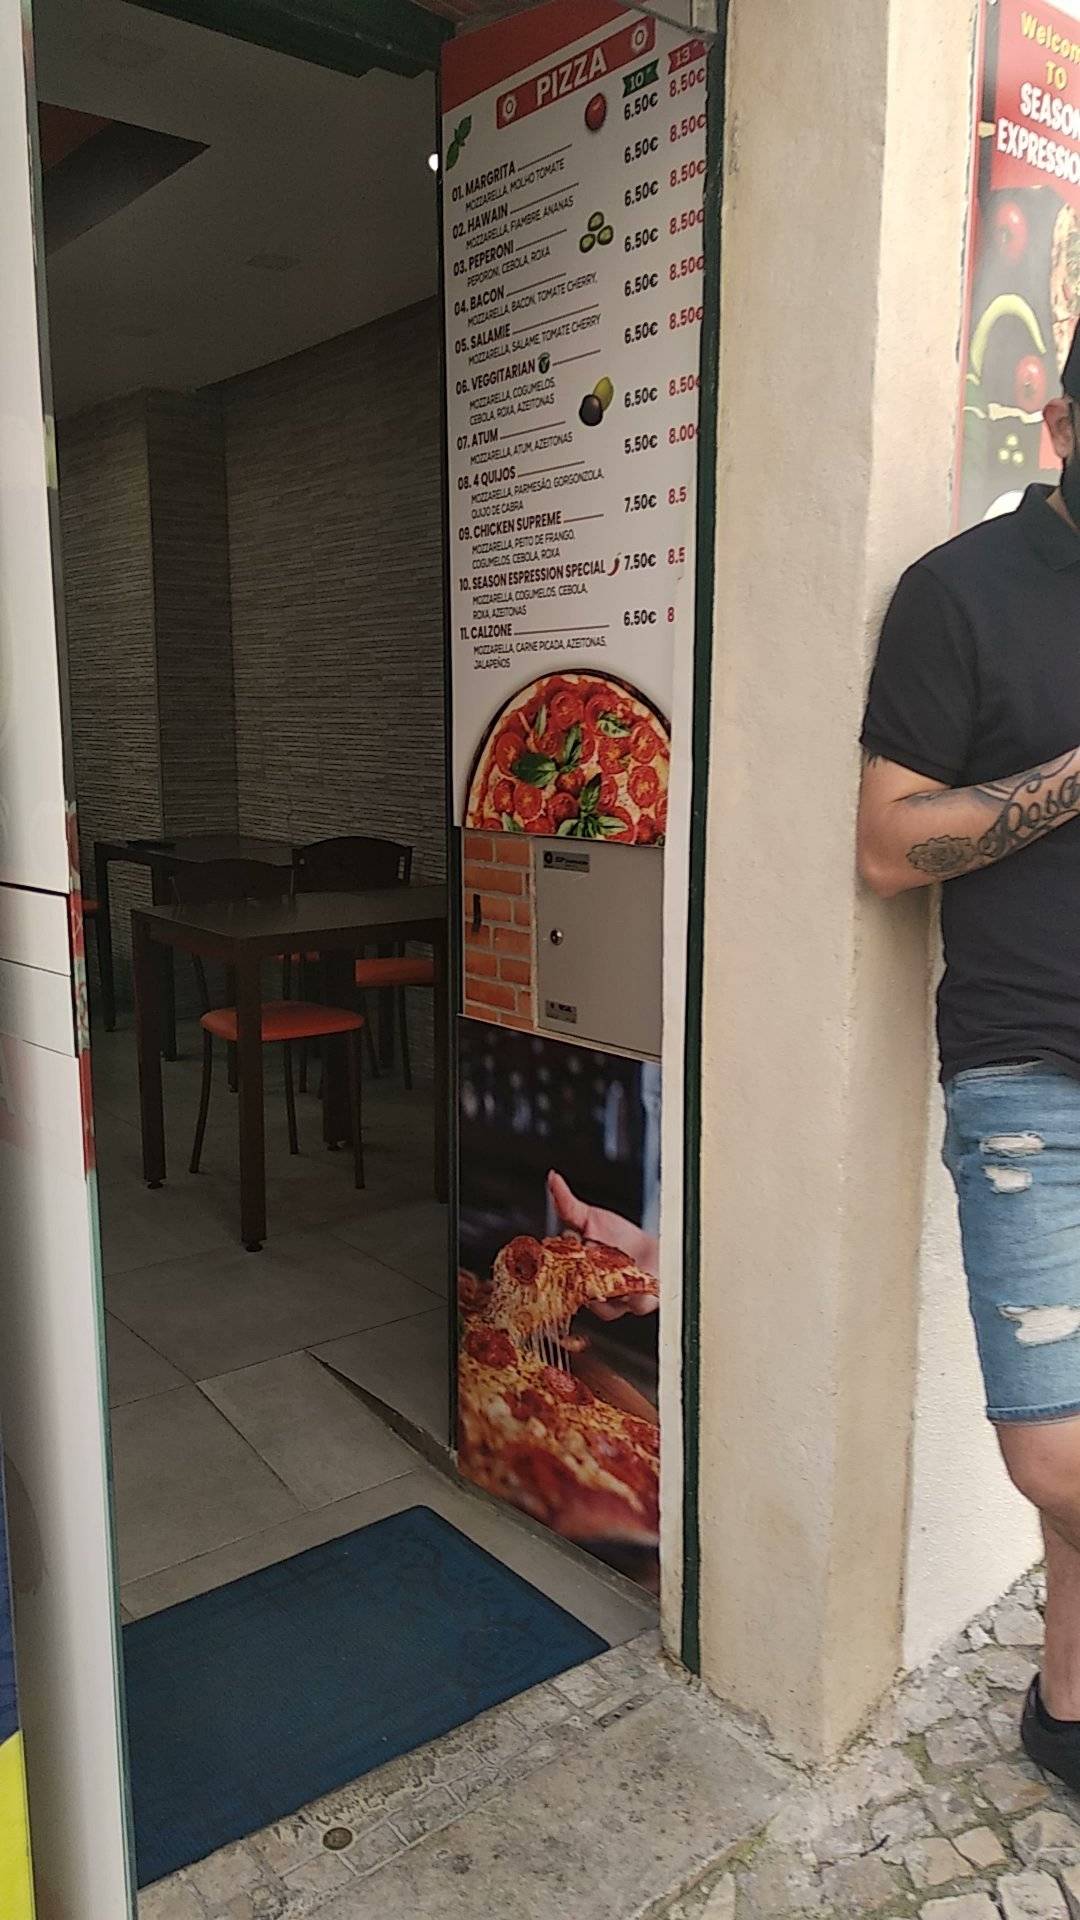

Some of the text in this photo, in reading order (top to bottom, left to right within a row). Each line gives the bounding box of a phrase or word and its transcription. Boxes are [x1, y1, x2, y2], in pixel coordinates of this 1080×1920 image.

[536, 46, 608, 106] PIZZA
[1046, 60, 1067, 91] TO
[624, 68, 705, 120] 6.50€ 8.50€
[624, 113, 706, 163] 6.50€ 8.50€
[452, 161, 516, 202] 01. MARGRITA
[510, 171, 535, 192] MOLHO
[536, 158, 565, 179] TOMATE
[624, 160, 706, 206] 6.50€ 8.50€
[467, 203, 509, 232] HAWAIN
[542, 195, 574, 217] ANANAS
[624, 208, 705, 252] 6.50€ 8.50€
[453, 240, 514, 276] 03. PEPERONI
[531, 246, 551, 262] ROXA
[624, 255, 704, 296] 6.50€ 8.50€
[454, 285, 505, 316] 04. BACON
[537, 282, 566, 302] TOMATE
[455, 323, 511, 354] 05. SALAMIE
[541, 324, 570, 341] TOMATE
[624, 306, 703, 344] 6.50€ 8.50€
[455, 358, 536, 395] 06. VEGGITARIAN
[624, 387, 658, 408] 6.50€
[456, 428, 499, 450] 07. ATUM
[624, 434, 658, 454] 5.50€
[457, 465, 517, 490] 08. 4 QUIJOS
[501, 500, 524, 514] CABRA
[624, 494, 657, 513] 7.50€
[458, 510, 562, 541] 09. CHICKEN SUPREME
[514, 535, 534, 548] PEITO
[534, 533, 544, 545] DE
[541, 547, 560, 559] ROXA
[459, 559, 606, 591] 10. SEASON ESPRESSION SPECIAL
[624, 553, 656, 570] 7.50€
[470, 623, 513, 639] CALZONE
[623, 609, 656, 626] 6.50€
[515, 640, 538, 651] CARNE
